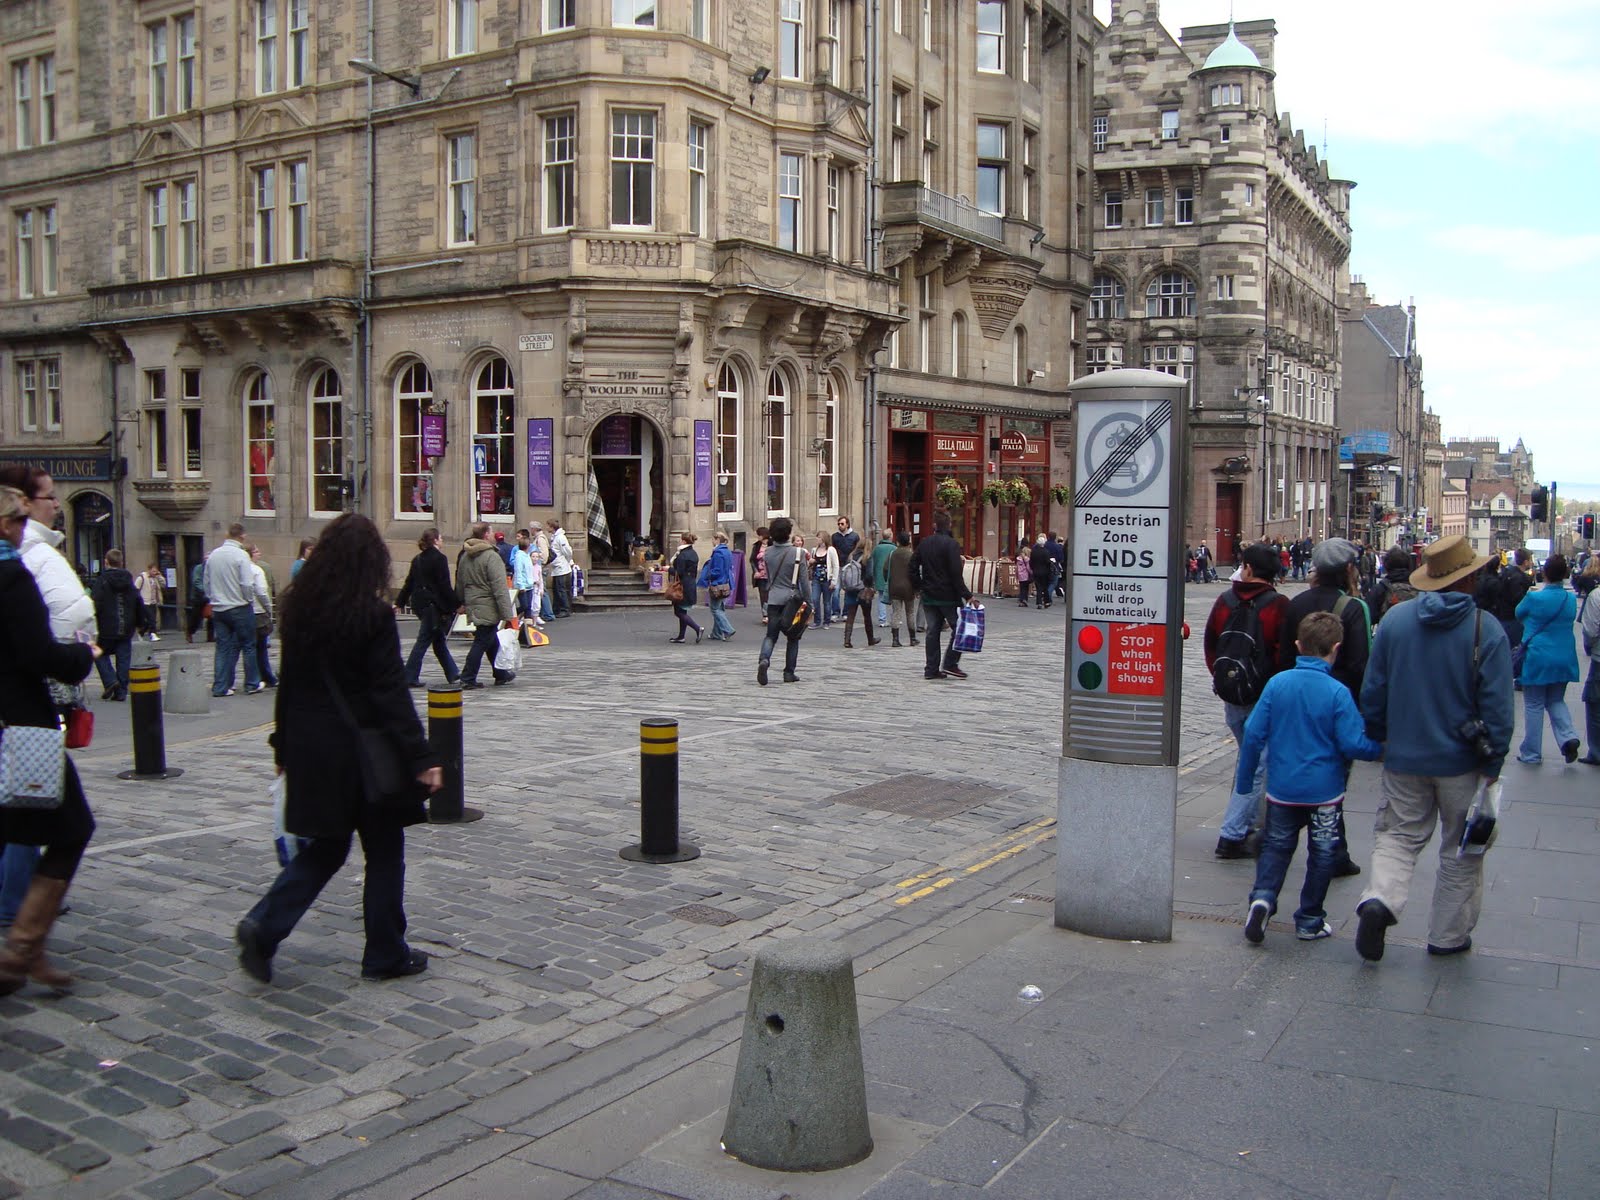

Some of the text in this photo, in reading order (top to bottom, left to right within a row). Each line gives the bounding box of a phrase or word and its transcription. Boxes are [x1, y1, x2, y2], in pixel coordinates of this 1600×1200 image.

[520, 334, 553, 342] COCKBURN
[525, 342, 547, 350] STREET
[617, 371, 638, 380] THE
[589, 386, 667, 395] WOOLLEN MILL
[937, 440, 974, 451] BELLA ITALIA
[50, 460, 97, 476] LOUNGE
[1084, 513, 1161, 527] Pedestrian
[1103, 530, 1138, 543] Zone
[1088, 548, 1154, 569] ENDS
[1096, 581, 1142, 592] Bollards
[1095, 594, 1144, 605] will drop
[1083, 606, 1157, 619] automatically
[1120, 635, 1154, 647] STOP
[1121, 649, 1152, 659] when
[1111, 661, 1162, 673] red light
[1117, 673, 1154, 684] shows
